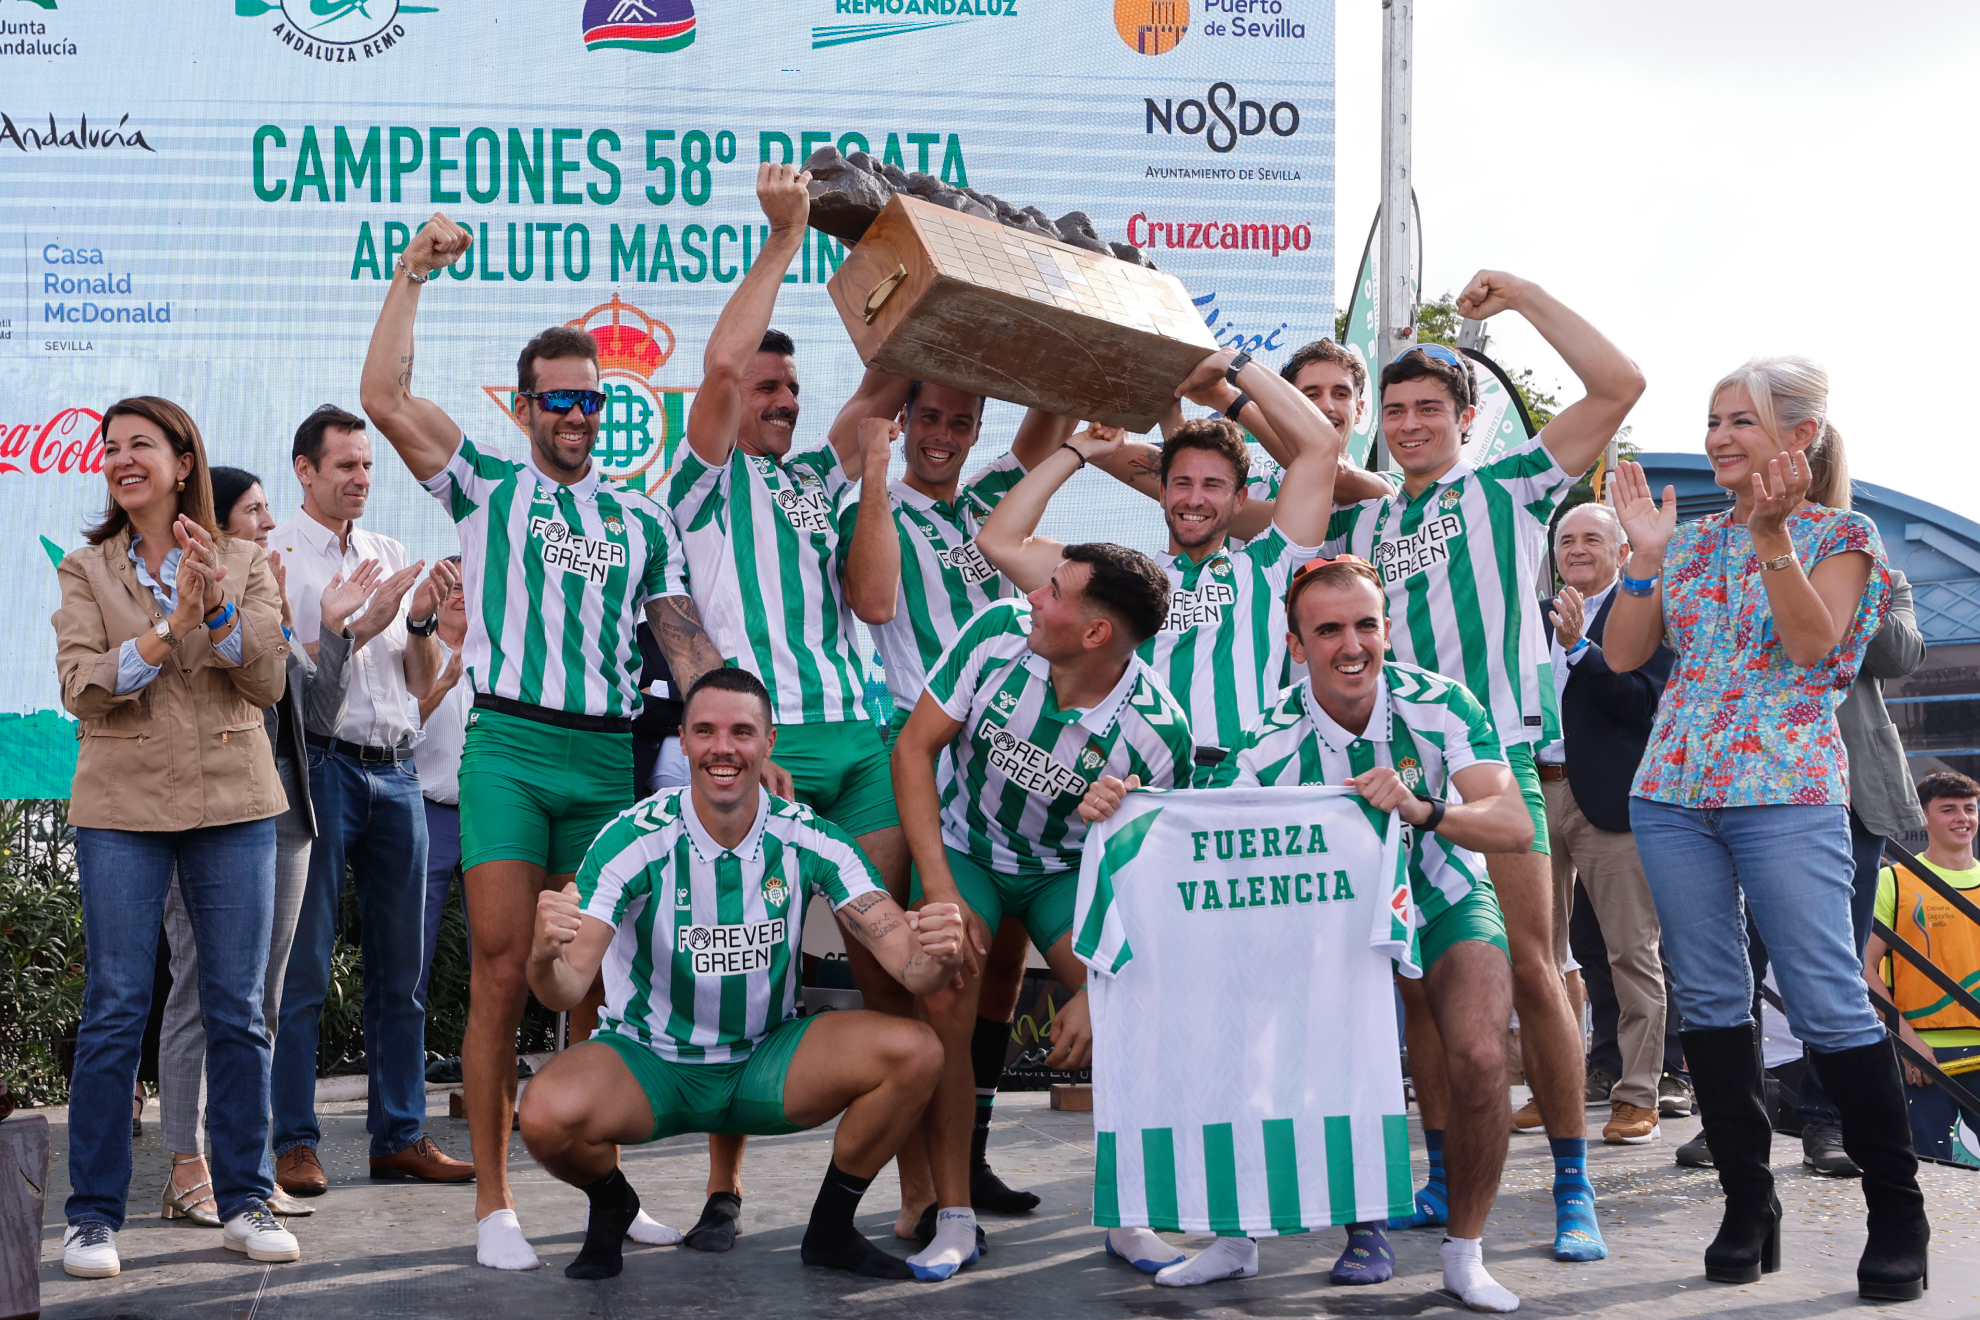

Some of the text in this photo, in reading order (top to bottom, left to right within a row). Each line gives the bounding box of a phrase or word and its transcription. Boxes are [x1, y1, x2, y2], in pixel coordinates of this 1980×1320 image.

[836, 0, 1017, 16] REMOANDALUZ
[1205, 0, 1282, 14] Puerto
[0, 20, 46, 35] Junta
[1204, 17, 1305, 38] de Sevilla
[0, 37, 78, 55] ndalucía
[272, 23, 405, 62] ANDALUZA REMO
[252, 124, 622, 205] CAMPEONES
[1239, 169, 1254, 180] DE
[1126, 211, 1312, 257] Cruzcampo
[43, 243, 104, 265] Casa
[44, 272, 132, 294] Ronald
[44, 302, 172, 323] McDonald
[44, 340, 94, 351] SEVILLA
[1384, 542, 1447, 583] GREEN
[980, 722, 1085, 794] FOREVER
[990, 749, 1059, 798] GREEN
[1191, 824, 1331, 863] FUERZA
[1177, 869, 1357, 913] VALENCIA
[680, 921, 783, 950] FOREVER
[695, 948, 769, 974] GREEN
